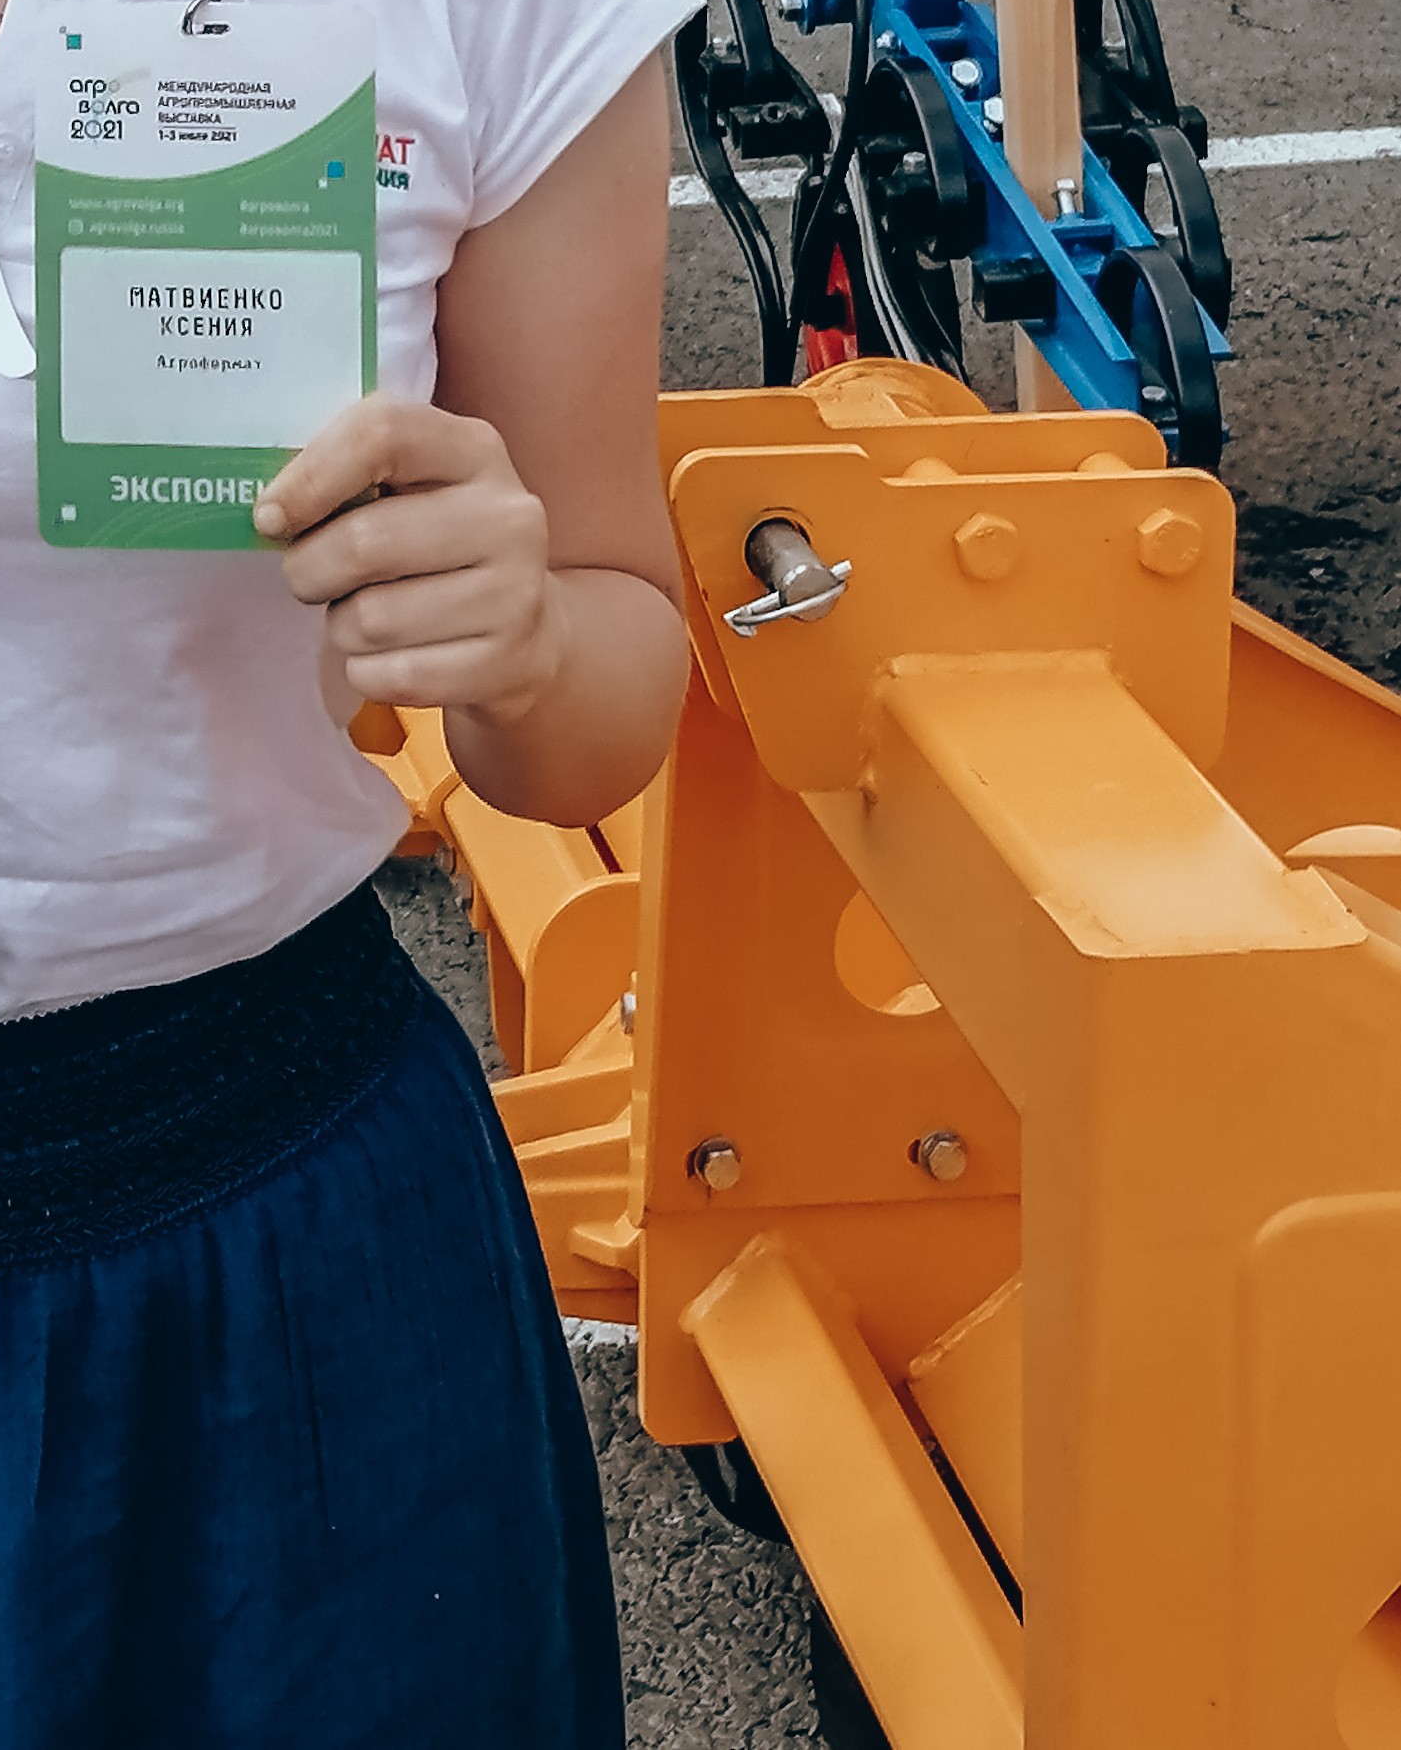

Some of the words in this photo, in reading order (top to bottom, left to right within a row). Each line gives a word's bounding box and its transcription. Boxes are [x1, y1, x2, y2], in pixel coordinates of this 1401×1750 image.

[70, 118, 124, 140] 2021
[129, 286, 283, 310] МАТВИЕНКО
[160, 315, 253, 336] КСЕНИЯ
[156, 354, 262, 372] Агроформат
